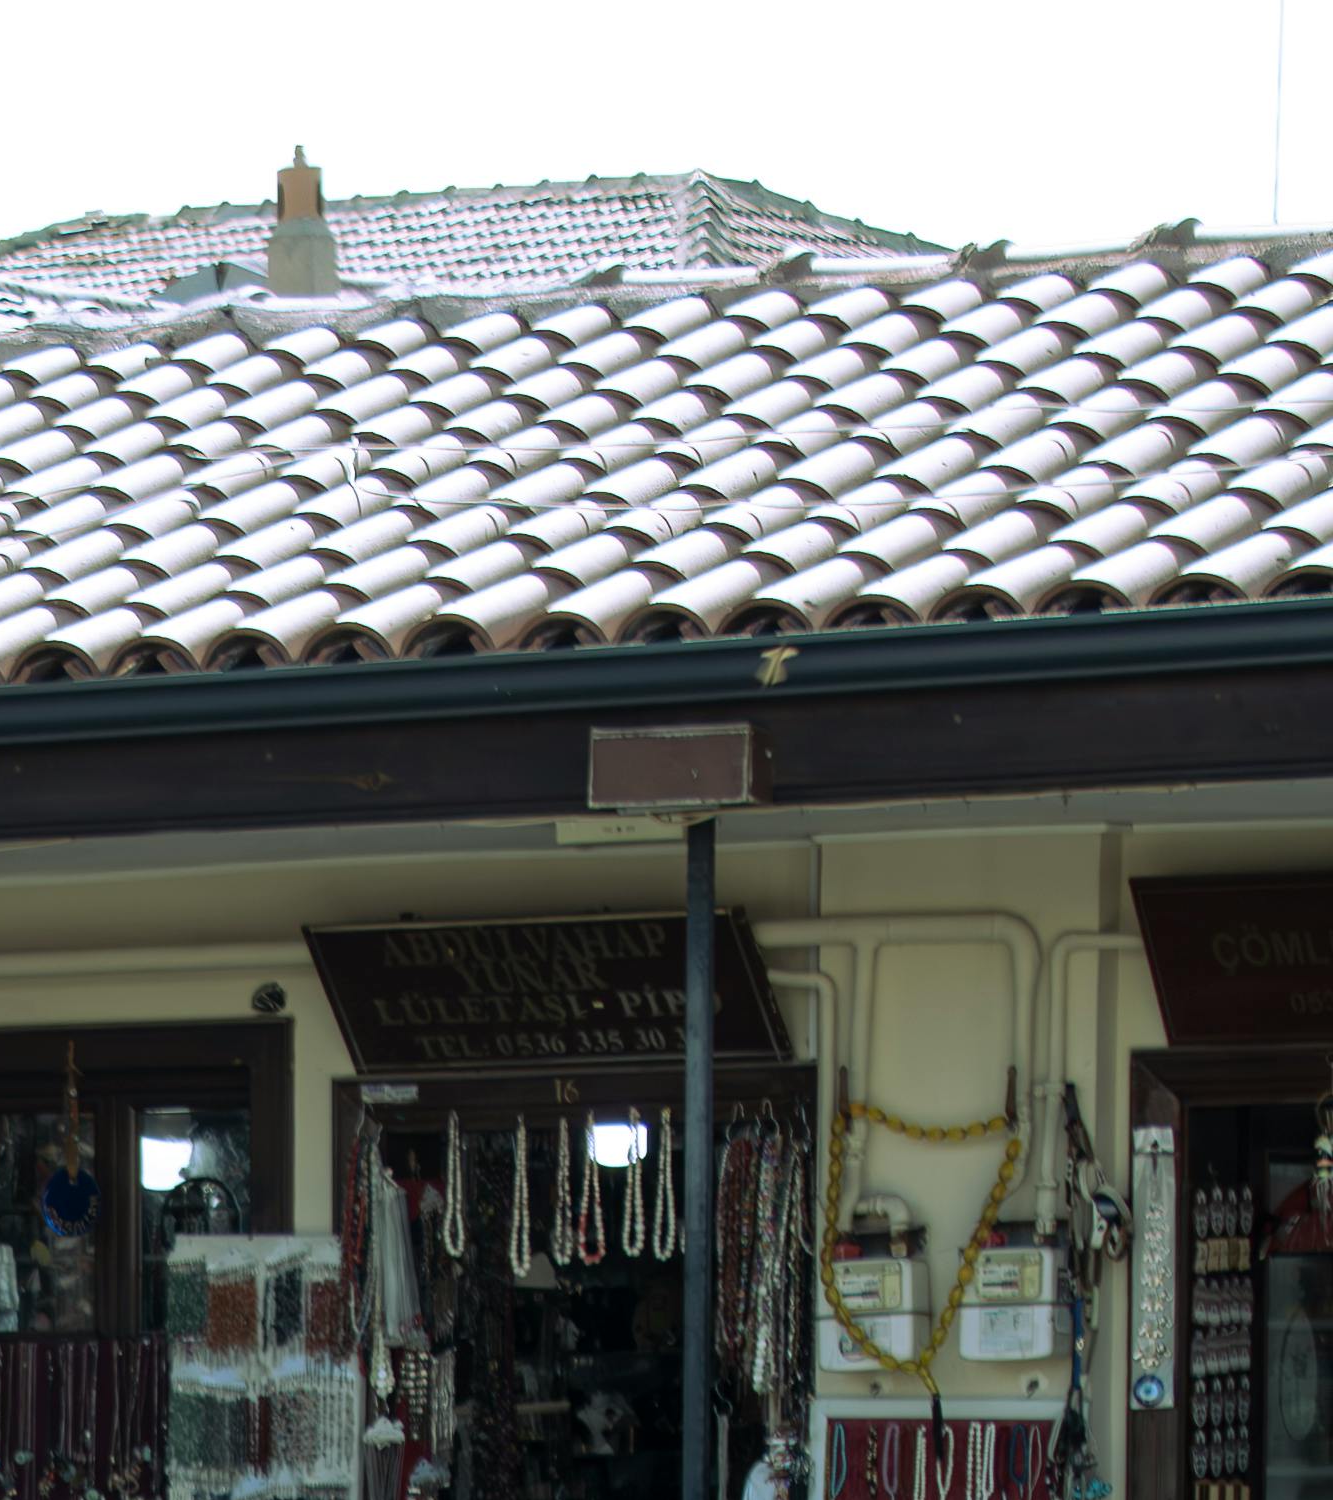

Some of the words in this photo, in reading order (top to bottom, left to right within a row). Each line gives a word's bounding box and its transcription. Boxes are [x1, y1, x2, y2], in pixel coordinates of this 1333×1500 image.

[1211, 921, 1333, 976] ÇÖML
[615, 983, 722, 1017] PİP
[497, 1033, 566, 1057] 0536
[577, 1028, 624, 1054] 335
[637, 1026, 667, 1051] 30
[553, 1078, 580, 1105] 16
